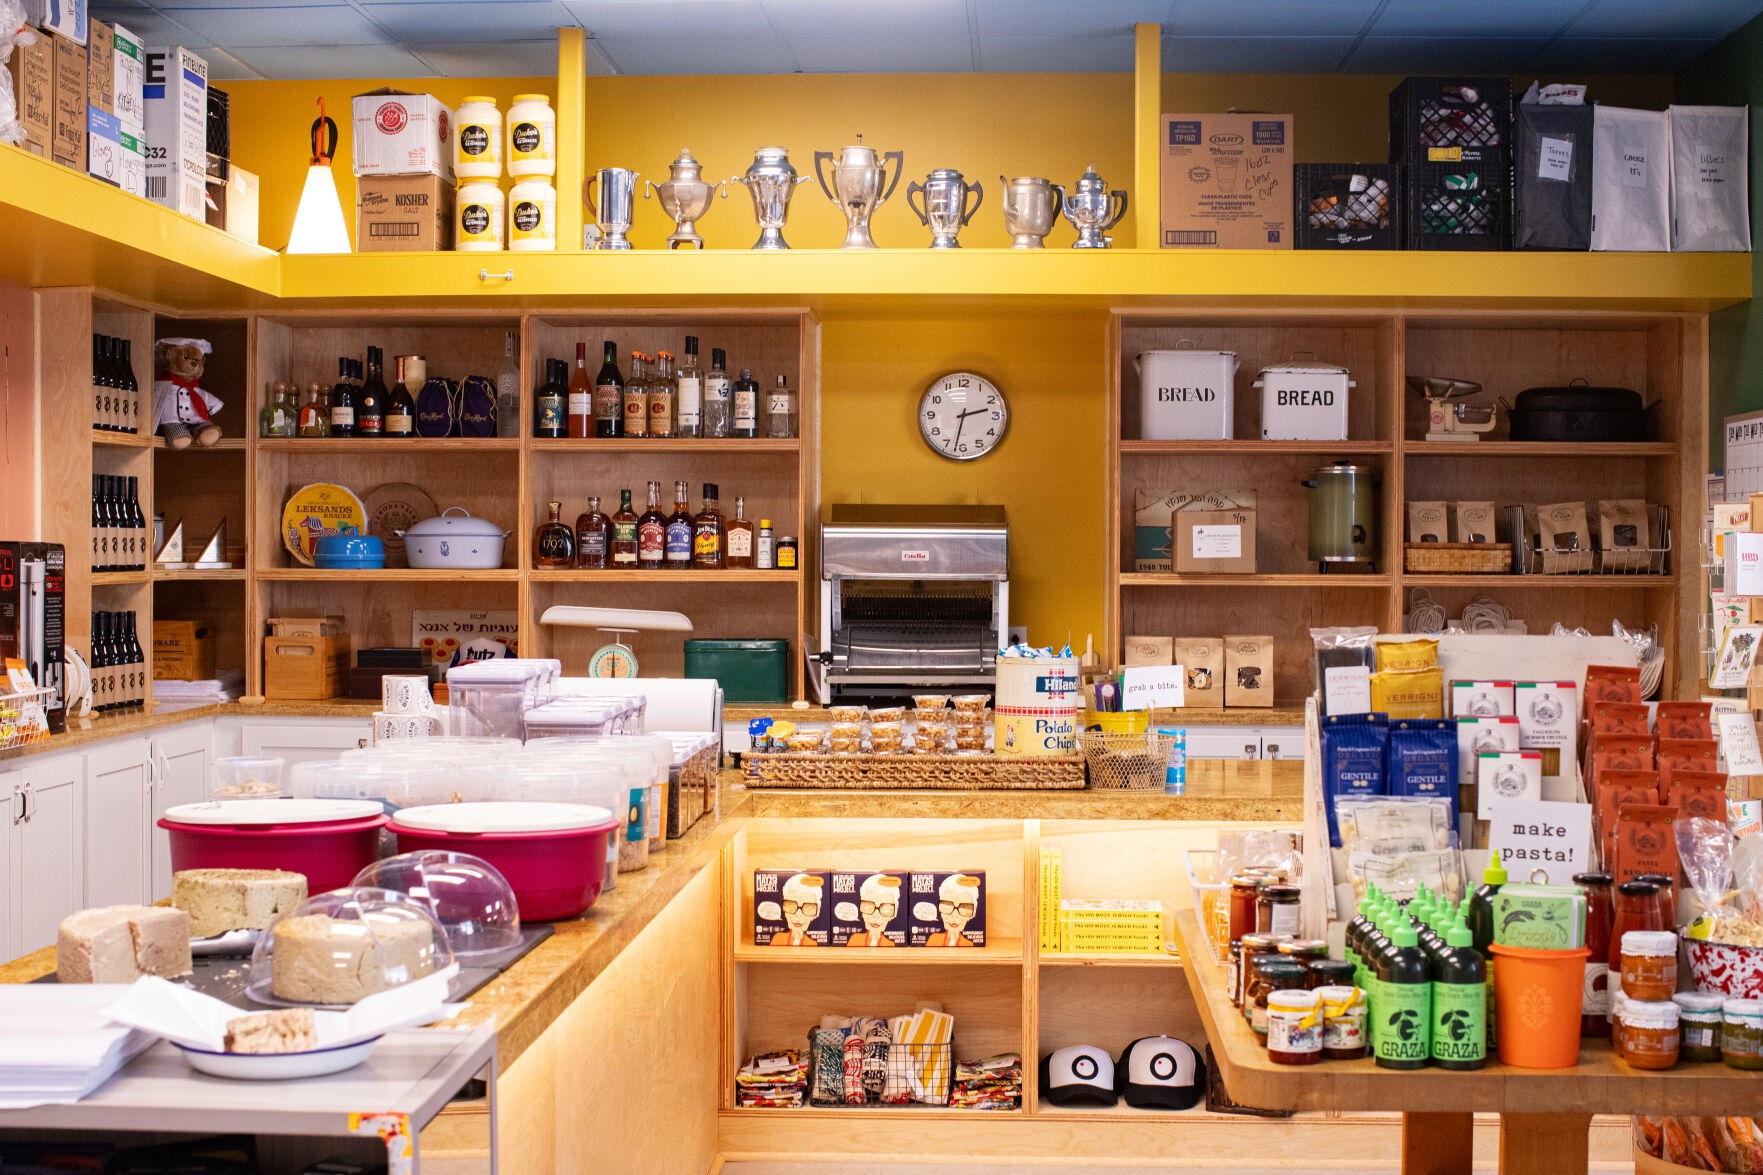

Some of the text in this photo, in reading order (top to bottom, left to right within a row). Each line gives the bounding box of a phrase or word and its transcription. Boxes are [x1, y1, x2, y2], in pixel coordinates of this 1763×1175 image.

[514, 128, 538, 138] Duke's
[395, 194, 428, 206] KOSHER
[945, 383, 951, 391] 11
[958, 379, 969, 388] 12
[979, 383, 981, 392] 1
[1158, 387, 1216, 402] BREAD
[1277, 390, 1334, 406] BREAD
[932, 396, 941, 404] 10
[987, 396, 996, 404] 2
[927, 411, 935, 419] 9
[991, 412, 1000, 420] 3
[986, 428, 995, 436] 4
[943, 439, 950, 448] 7
[959, 444, 967, 452] 6
[975, 440, 984, 448] 5
[296, 505, 352, 513] LEKSANDS
[696, 526, 704, 534] JIM
[542, 539, 563, 551] 1792
[1742, 553, 1758, 561] HBD
[420, 624, 449, 632] אמא
[454, 622, 474, 632] של
[1128, 682, 1146, 693] grab
[1157, 682, 1178, 690] bite.
[1385, 692, 1439, 701] VERRIGNI
[1036, 719, 1072, 734] Potato
[1044, 736, 1075, 753] Chips
[1513, 823, 1567, 837] make
[1502, 847, 1573, 862] pasta!
[1508, 926, 1556, 943] Drizzle
[1382, 1041, 1426, 1058] GRAZA
[1435, 1041, 1479, 1058] GRAZA
